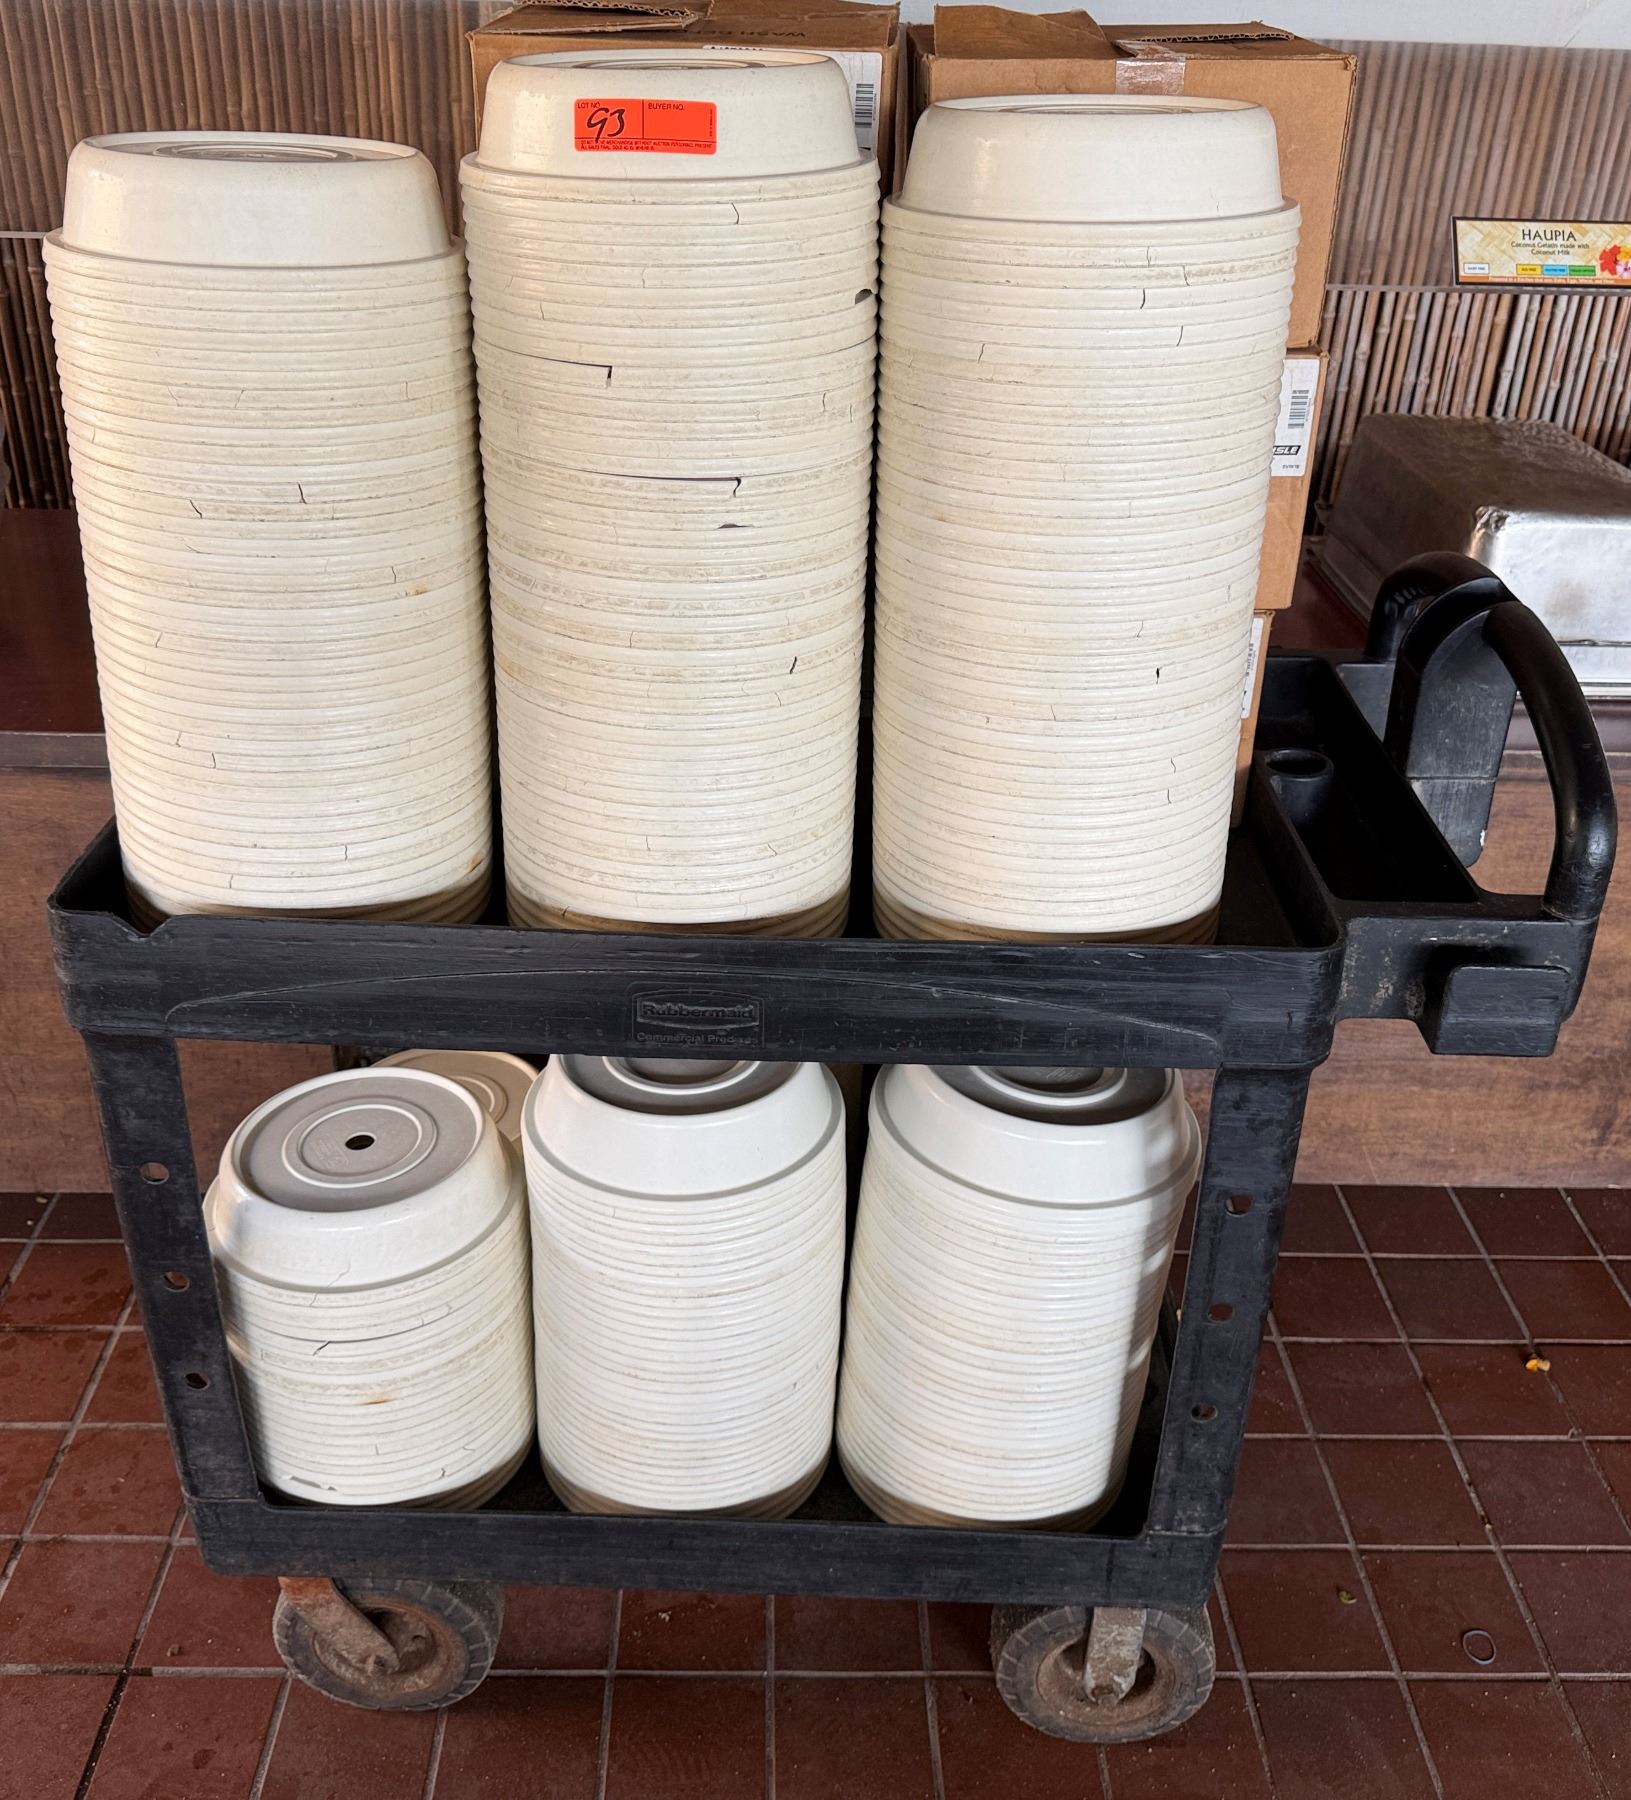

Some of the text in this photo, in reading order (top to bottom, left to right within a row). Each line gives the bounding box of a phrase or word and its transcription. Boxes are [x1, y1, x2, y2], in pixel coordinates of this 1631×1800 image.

[648, 102, 671, 110] BUYER
[587, 107, 625, 143] 93
[1522, 229, 1577, 241] HAUPIA
[642, 1001, 754, 1018] Rubbermaid
[636, 1032, 704, 1043] Commercial
